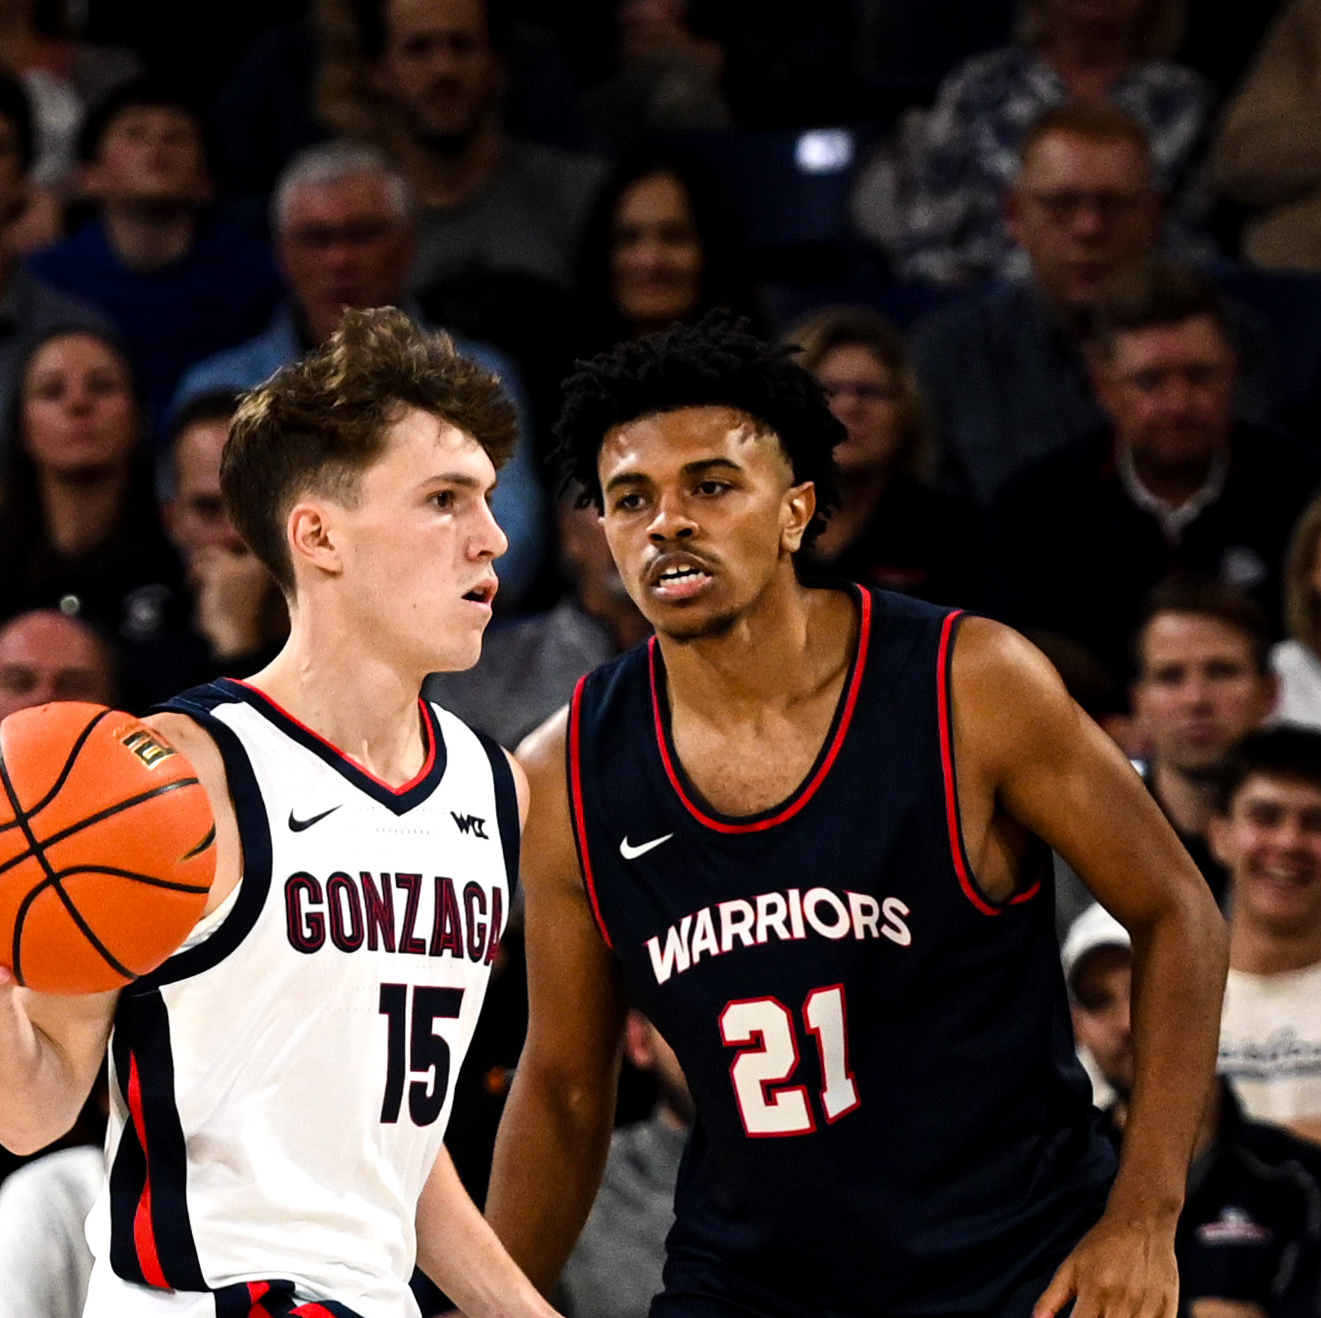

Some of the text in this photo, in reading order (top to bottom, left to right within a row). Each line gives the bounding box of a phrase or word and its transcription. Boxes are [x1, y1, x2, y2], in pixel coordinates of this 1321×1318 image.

[644, 886, 912, 985] WARRIORS
[378, 982, 466, 1128] 15
[717, 982, 862, 1138] 21
